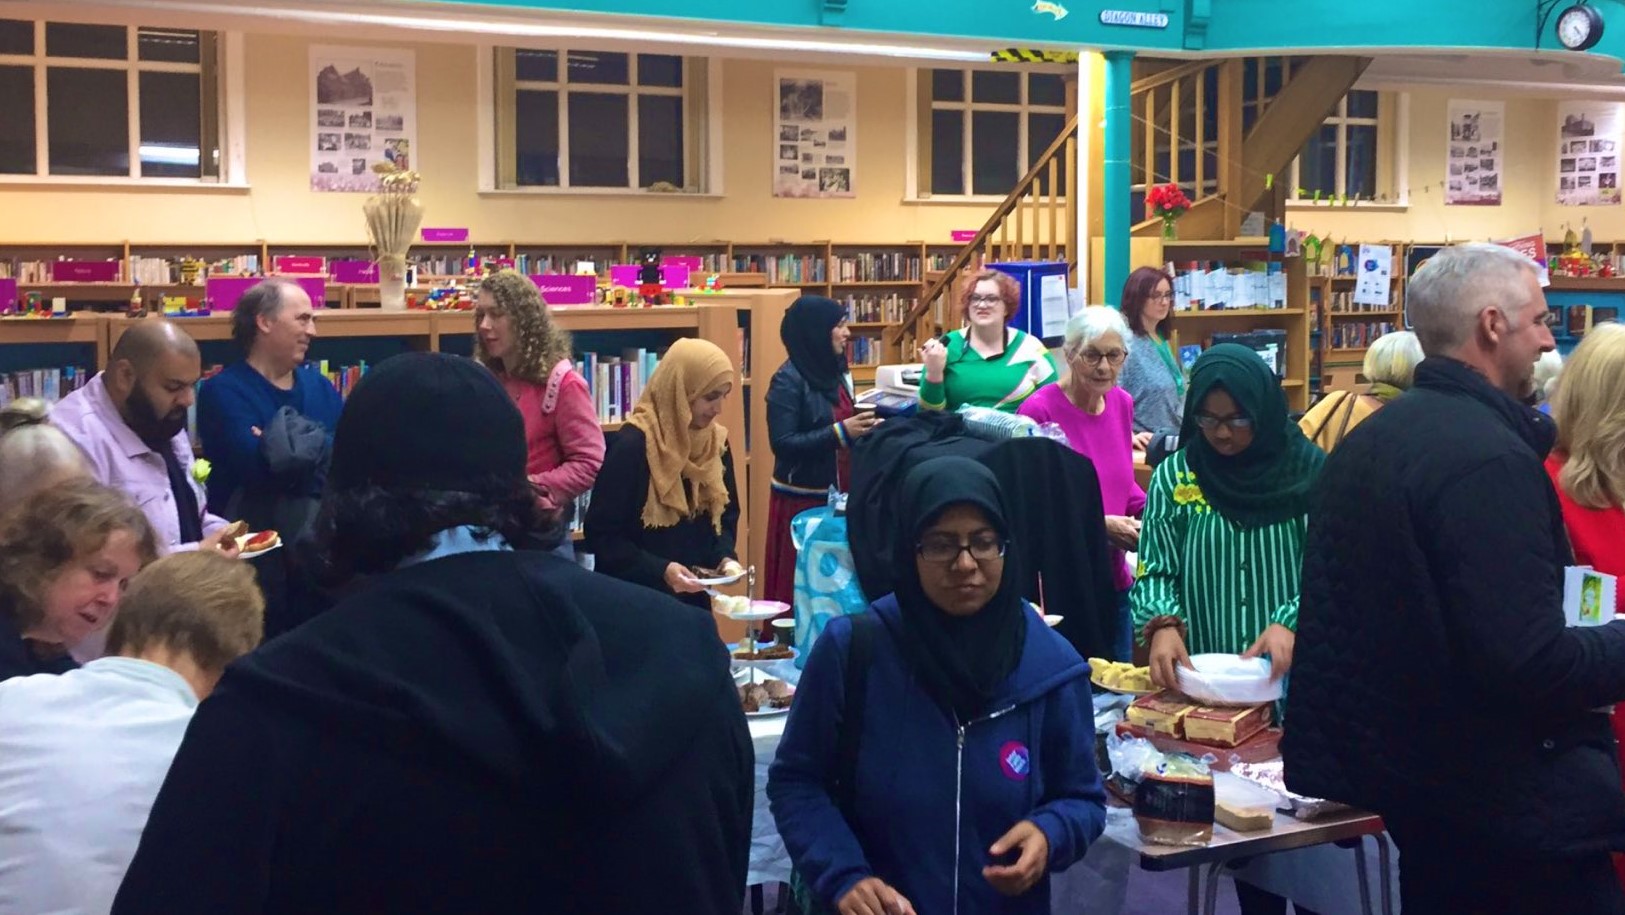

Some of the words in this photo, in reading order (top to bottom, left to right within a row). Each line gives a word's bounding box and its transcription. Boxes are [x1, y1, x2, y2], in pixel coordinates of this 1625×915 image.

[1103, 11, 1136, 24] DIAGON
[1138, 13, 1165, 26] ALLEY
[540, 285, 572, 293] Sciences
